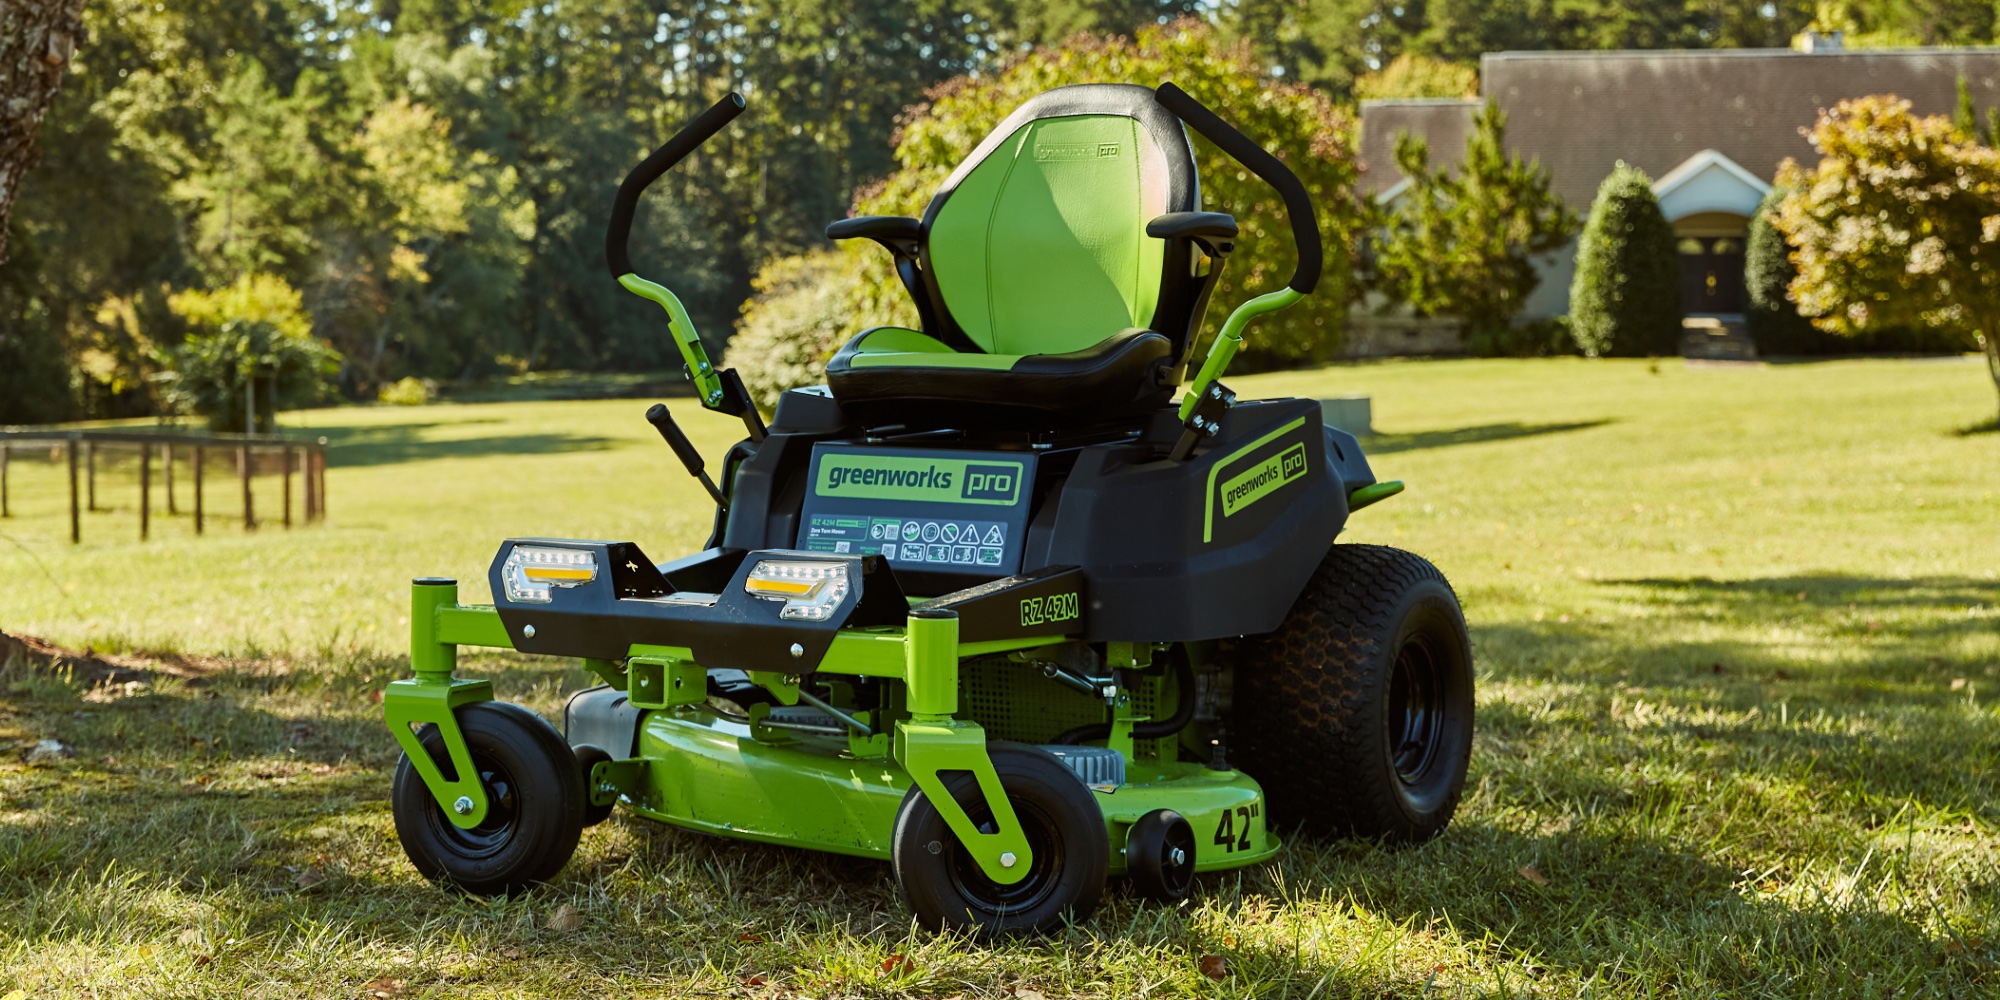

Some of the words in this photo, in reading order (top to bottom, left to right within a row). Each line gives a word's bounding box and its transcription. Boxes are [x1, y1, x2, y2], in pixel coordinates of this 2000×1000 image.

[1100, 147, 1118, 158] pro
[828, 465, 952, 489] greenworks
[967, 473, 1012, 496] pro
[1226, 465, 1279, 509] greenworks
[1283, 453, 1303, 477] pro
[1020, 597, 1044, 626] RZ
[1045, 592, 1079, 622] 42M
[1213, 803, 1259, 853] 42"
